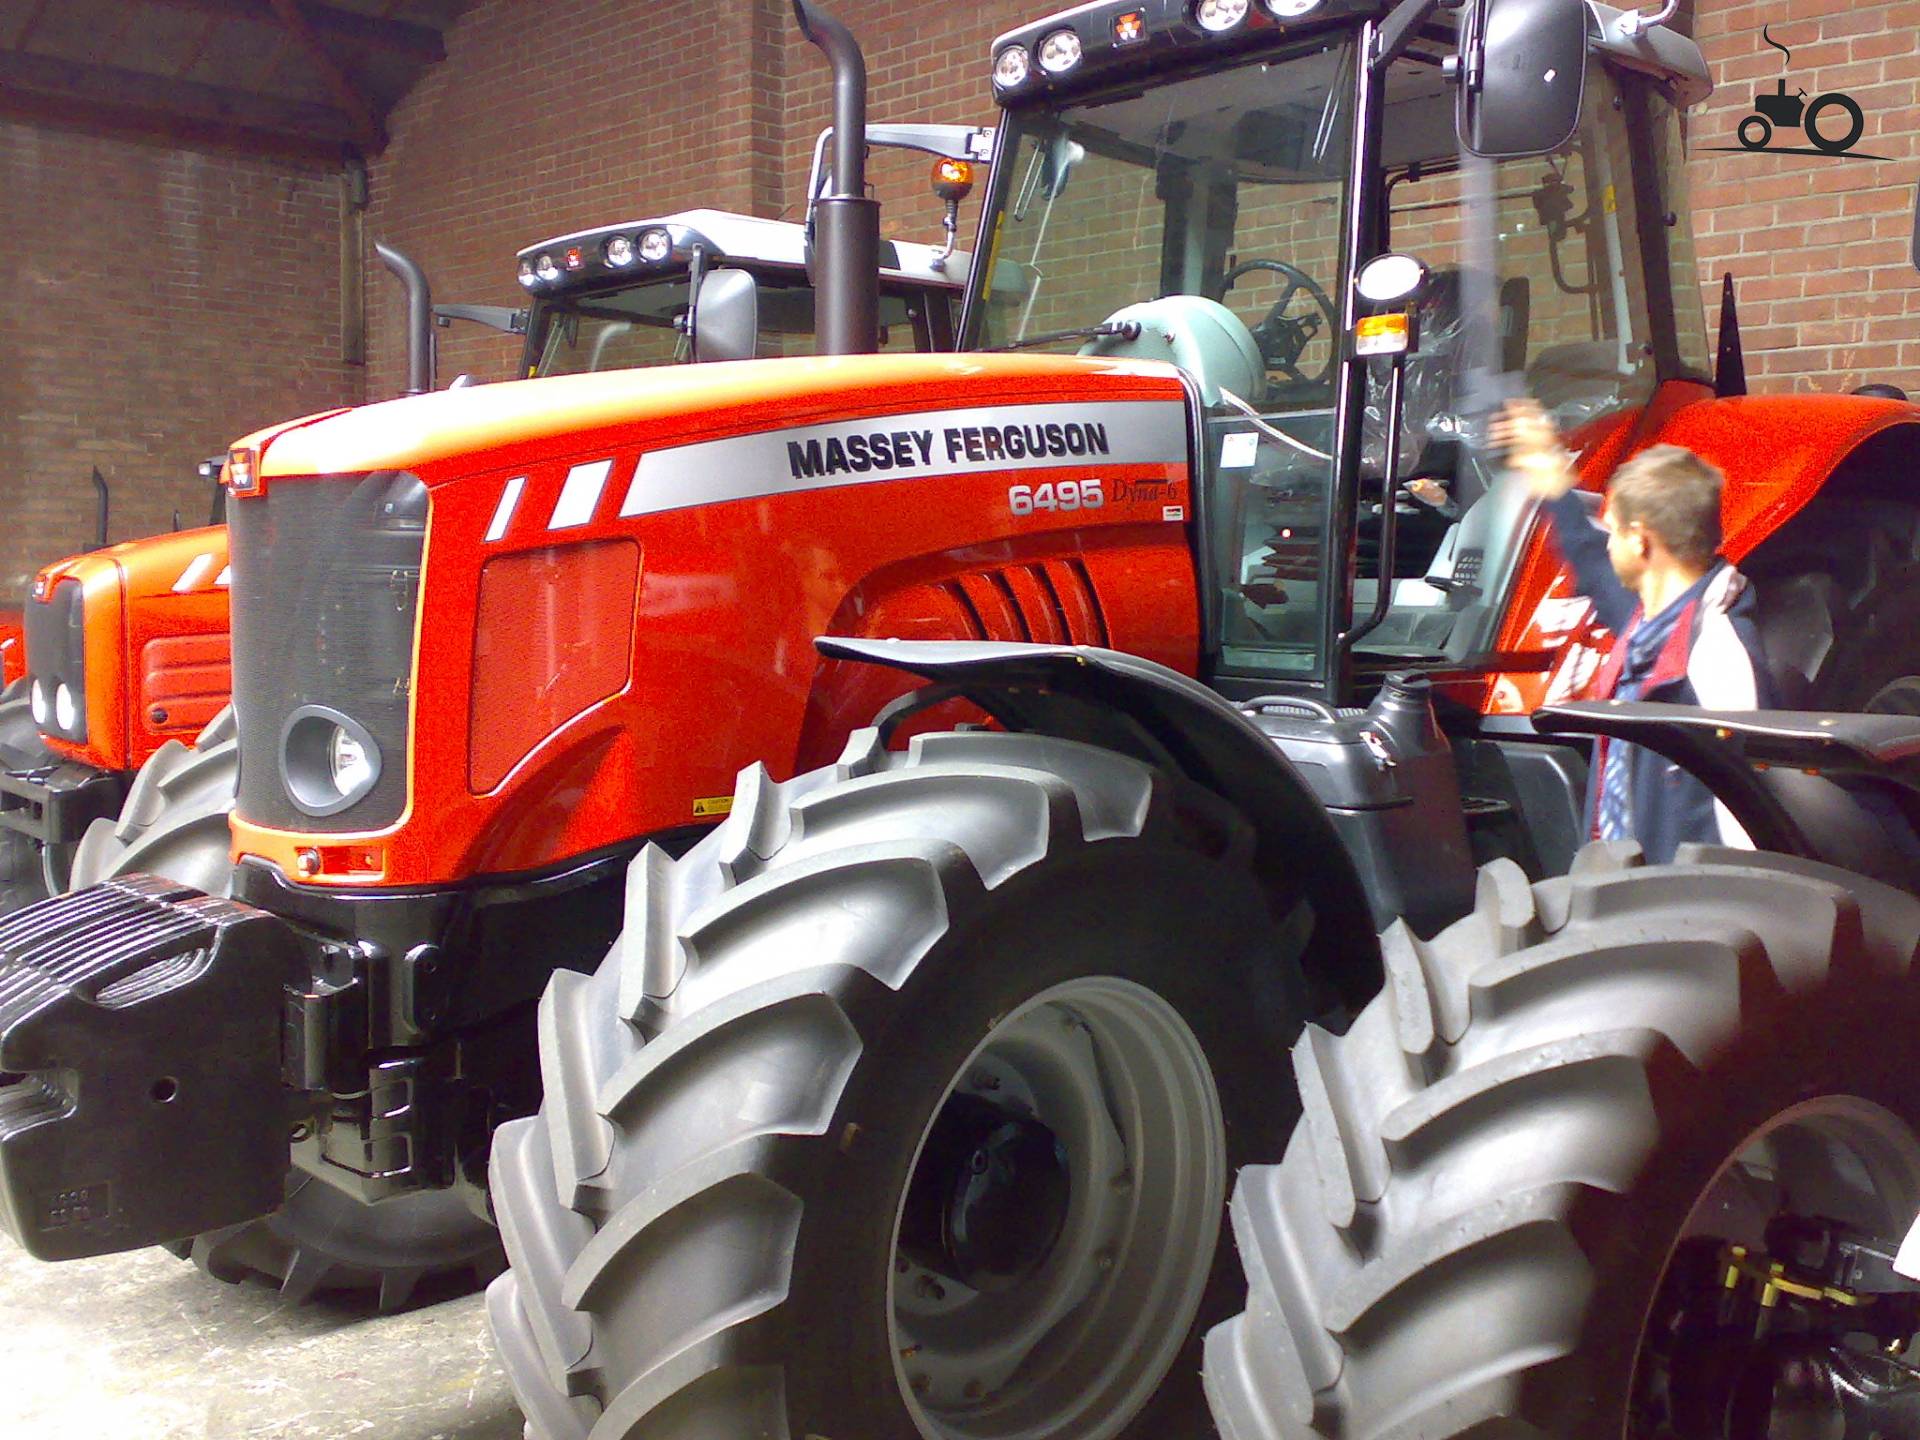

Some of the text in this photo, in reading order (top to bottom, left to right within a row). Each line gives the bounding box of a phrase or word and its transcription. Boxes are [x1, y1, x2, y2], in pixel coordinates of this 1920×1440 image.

[787, 423, 1109, 479] MASSEY FERGUSON
[1009, 479, 1177, 516] 6495 Dyna-6
